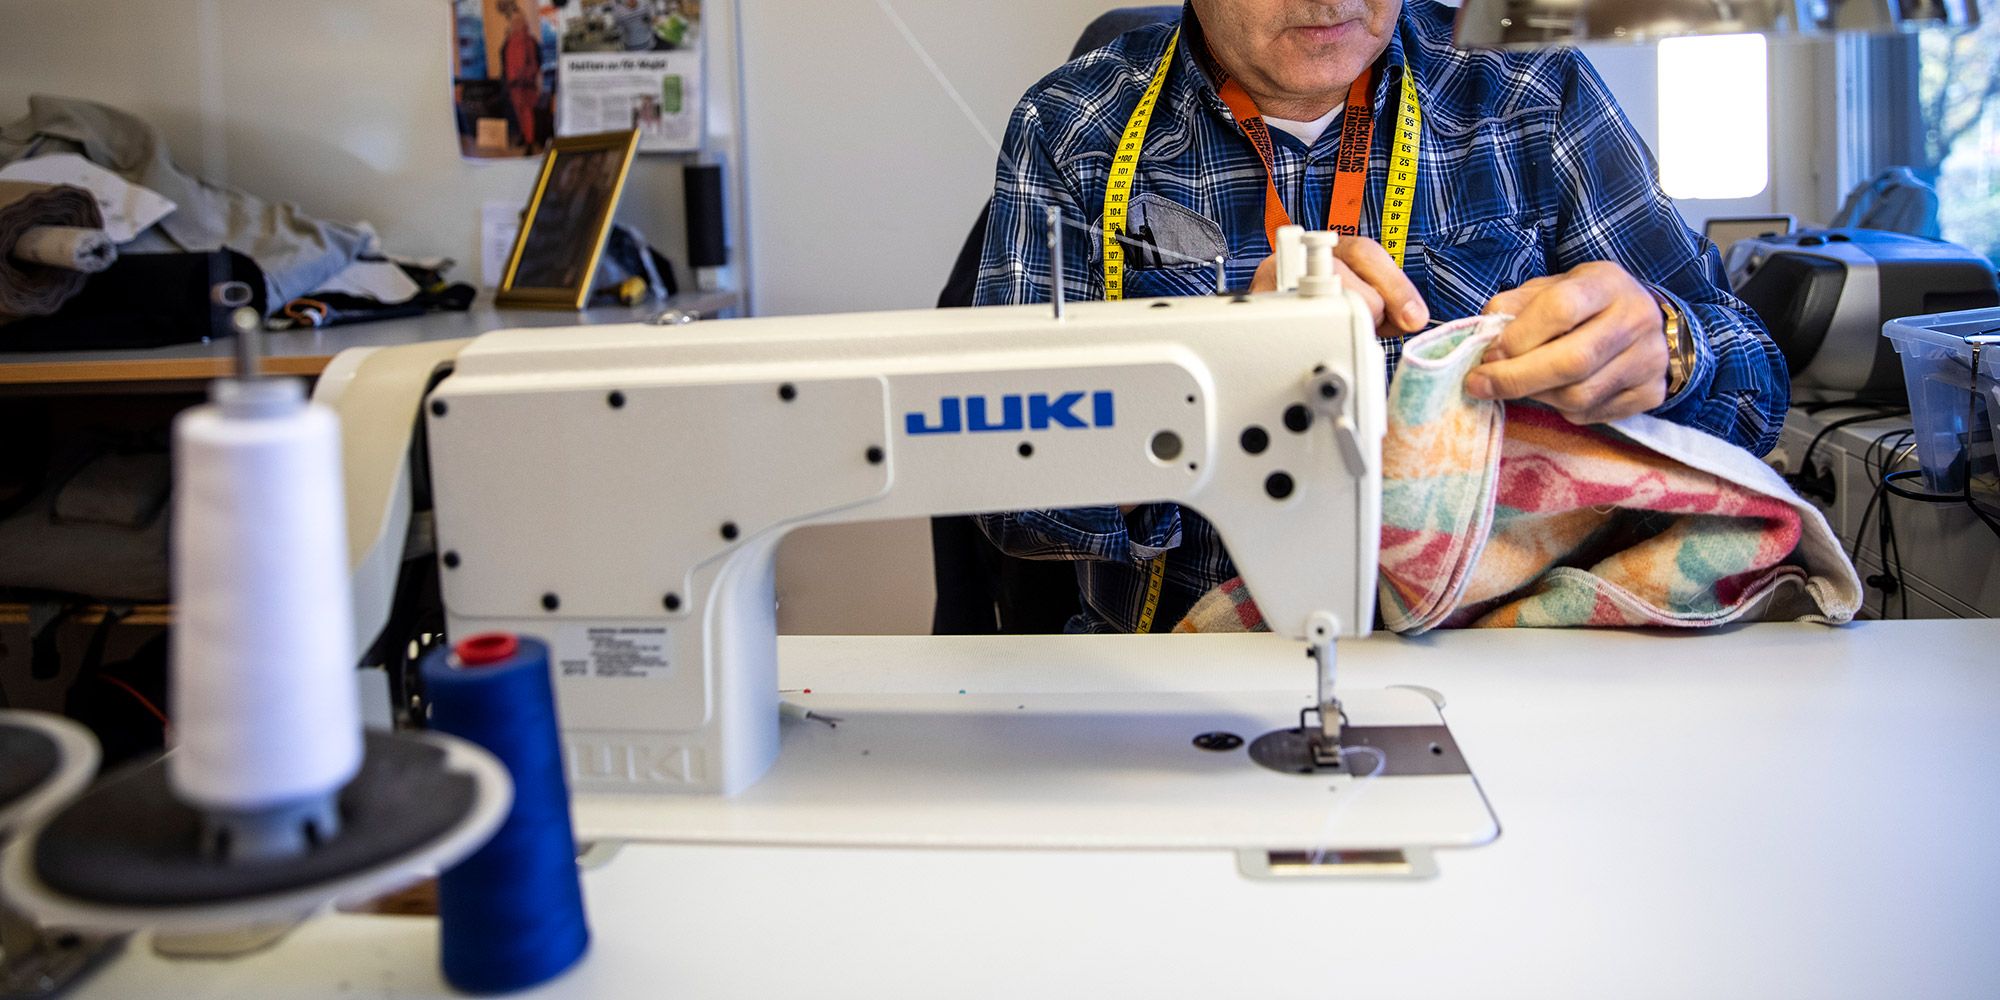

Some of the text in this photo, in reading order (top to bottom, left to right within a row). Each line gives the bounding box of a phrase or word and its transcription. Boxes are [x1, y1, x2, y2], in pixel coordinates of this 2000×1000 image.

[1406, 104, 1415, 114] 56
[1405, 118, 1414, 127] 55
[1339, 105, 1359, 173] STADSMISSION
[1351, 105, 1371, 174] STOCKHOLMS
[1403, 131, 1413, 140] 54
[1401, 144, 1411, 153] 53
[1399, 158, 1410, 167] 52
[1397, 172, 1407, 181] 51
[1395, 187, 1405, 195] 50
[1109, 222, 1120, 230] 105
[1389, 226, 1399, 234] 47
[1387, 240, 1397, 248] 46
[1108, 266, 1118, 274] 108
[1108, 280, 1118, 288] 109
[905, 390, 1115, 435] JUKI
[571, 745, 707, 784] UKI
